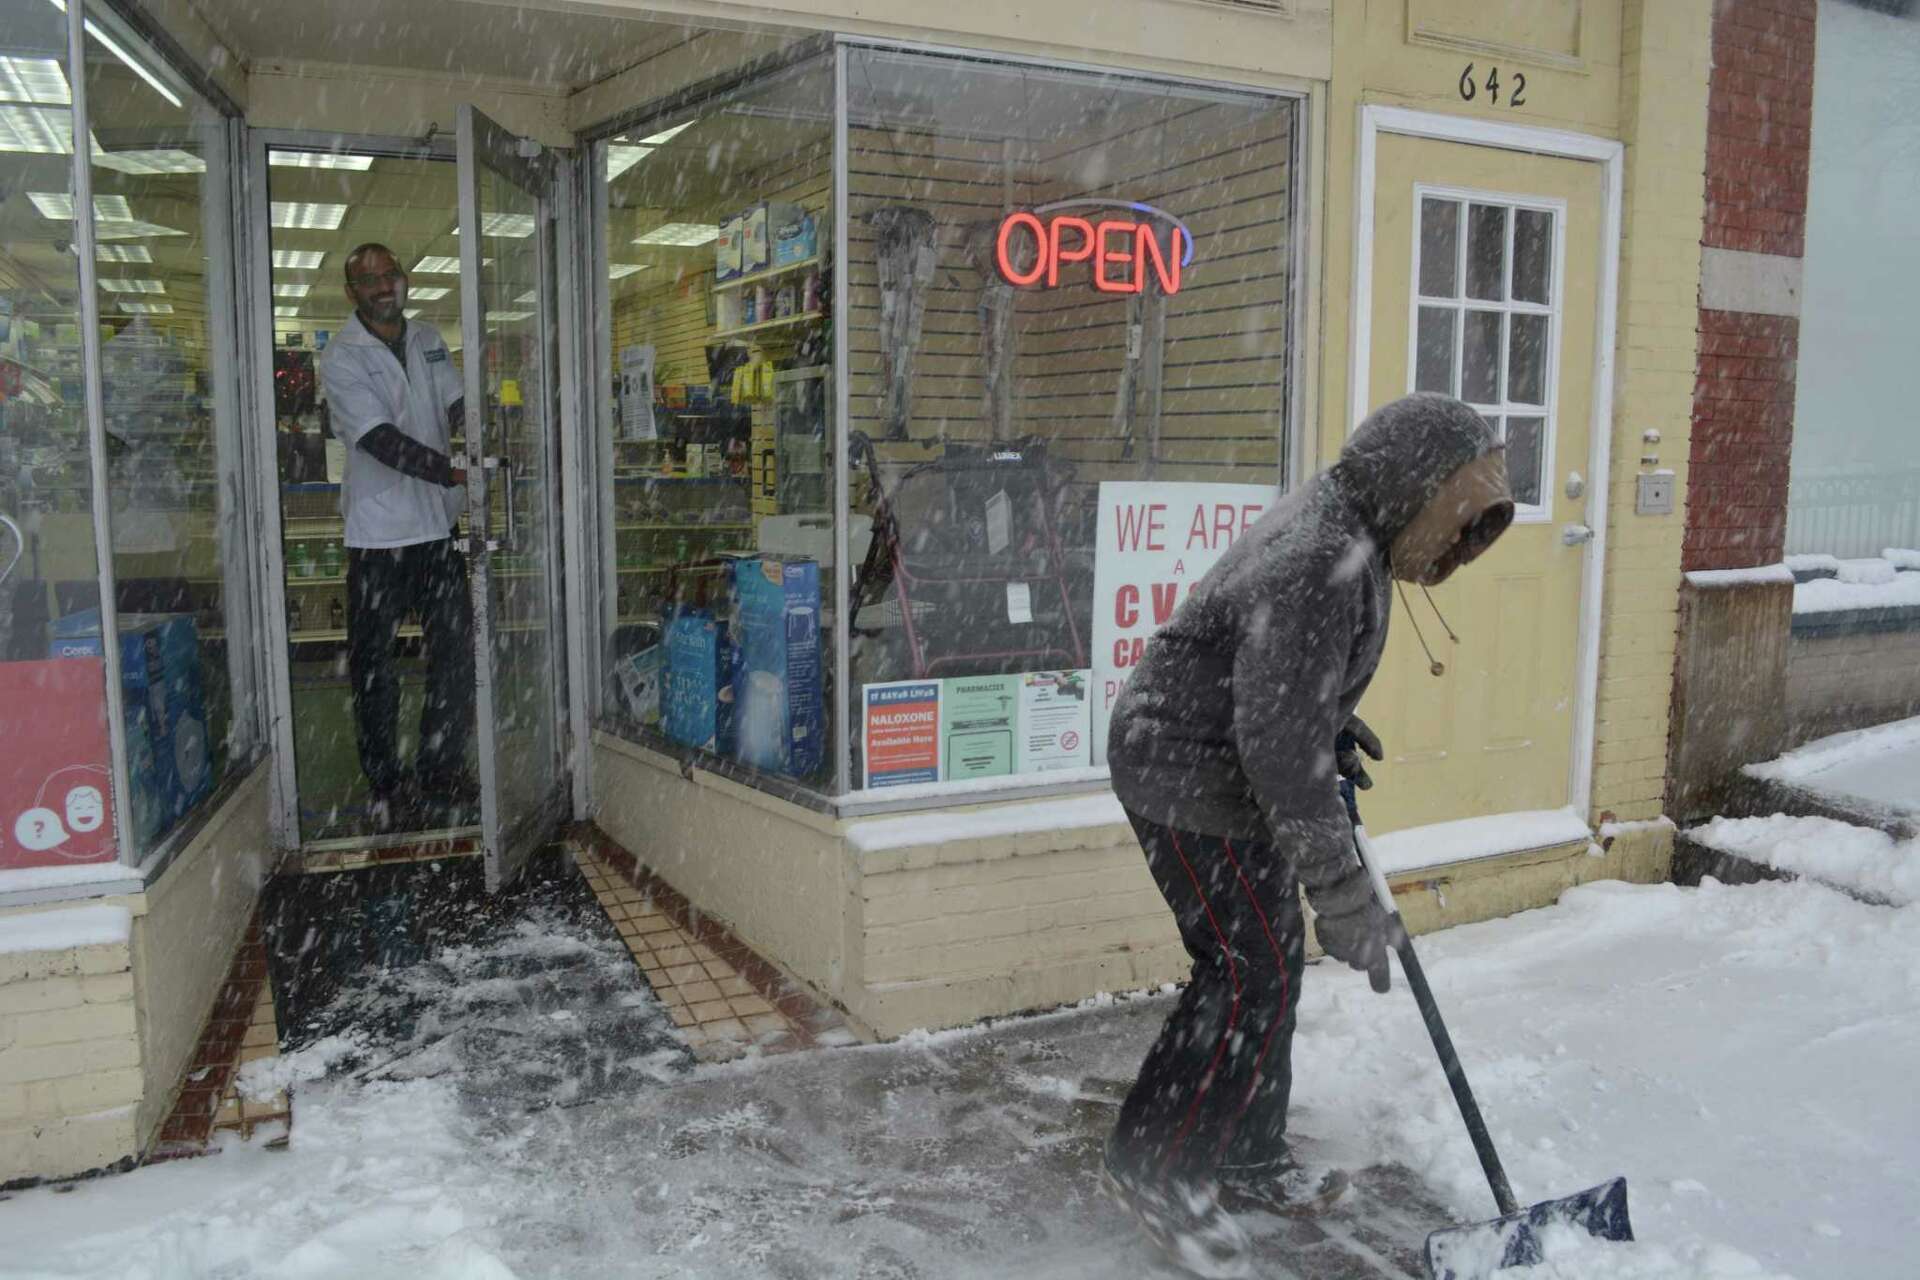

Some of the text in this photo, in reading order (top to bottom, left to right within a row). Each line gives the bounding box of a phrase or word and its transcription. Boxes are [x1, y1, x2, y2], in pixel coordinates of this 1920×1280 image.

[1459, 62, 1526, 107] 642
[997, 211, 1182, 295] OPEN
[1115, 503, 1168, 552] WE
[1173, 559, 1185, 575] A
[1114, 581, 1201, 629] CV
[870, 711, 935, 726] NALOXONE
